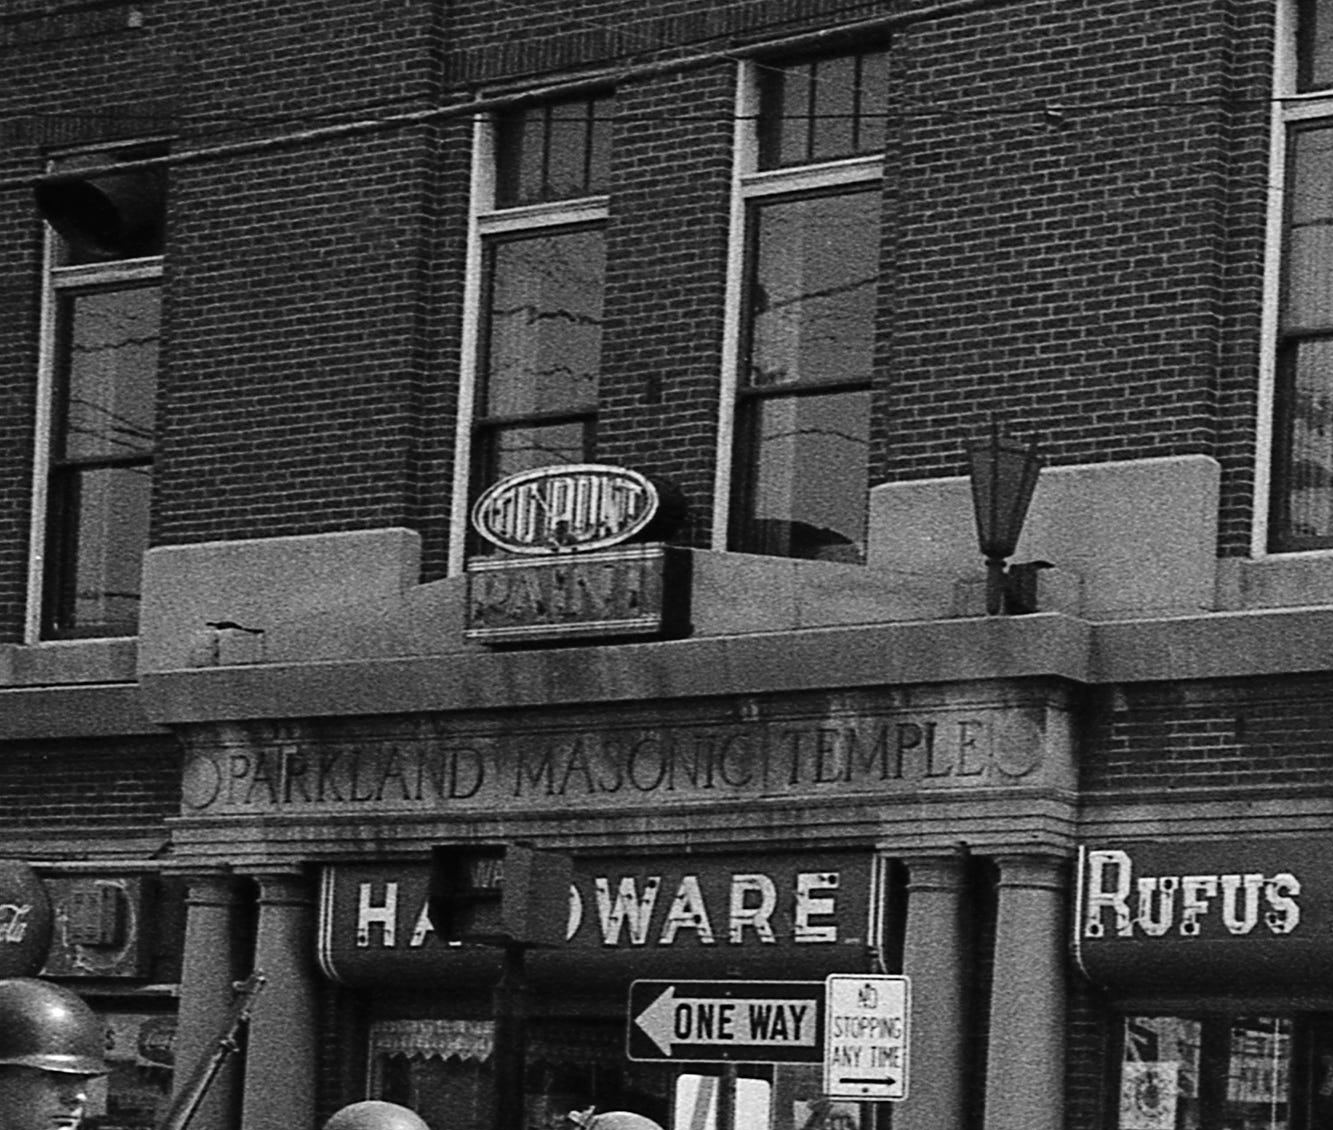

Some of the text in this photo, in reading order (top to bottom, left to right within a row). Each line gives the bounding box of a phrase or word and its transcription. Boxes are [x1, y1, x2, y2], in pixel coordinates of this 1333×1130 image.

[228, 719, 990, 804] PARKLAND MASONIC TEMPLE
[357, 872, 839, 947] HWARE
[1082, 848, 1301, 938] RUFUS
[674, 1003, 808, 1041] ONE WAY
[833, 1016, 901, 1039] STOPPING
[832, 1045, 900, 1068] ANY TIME
